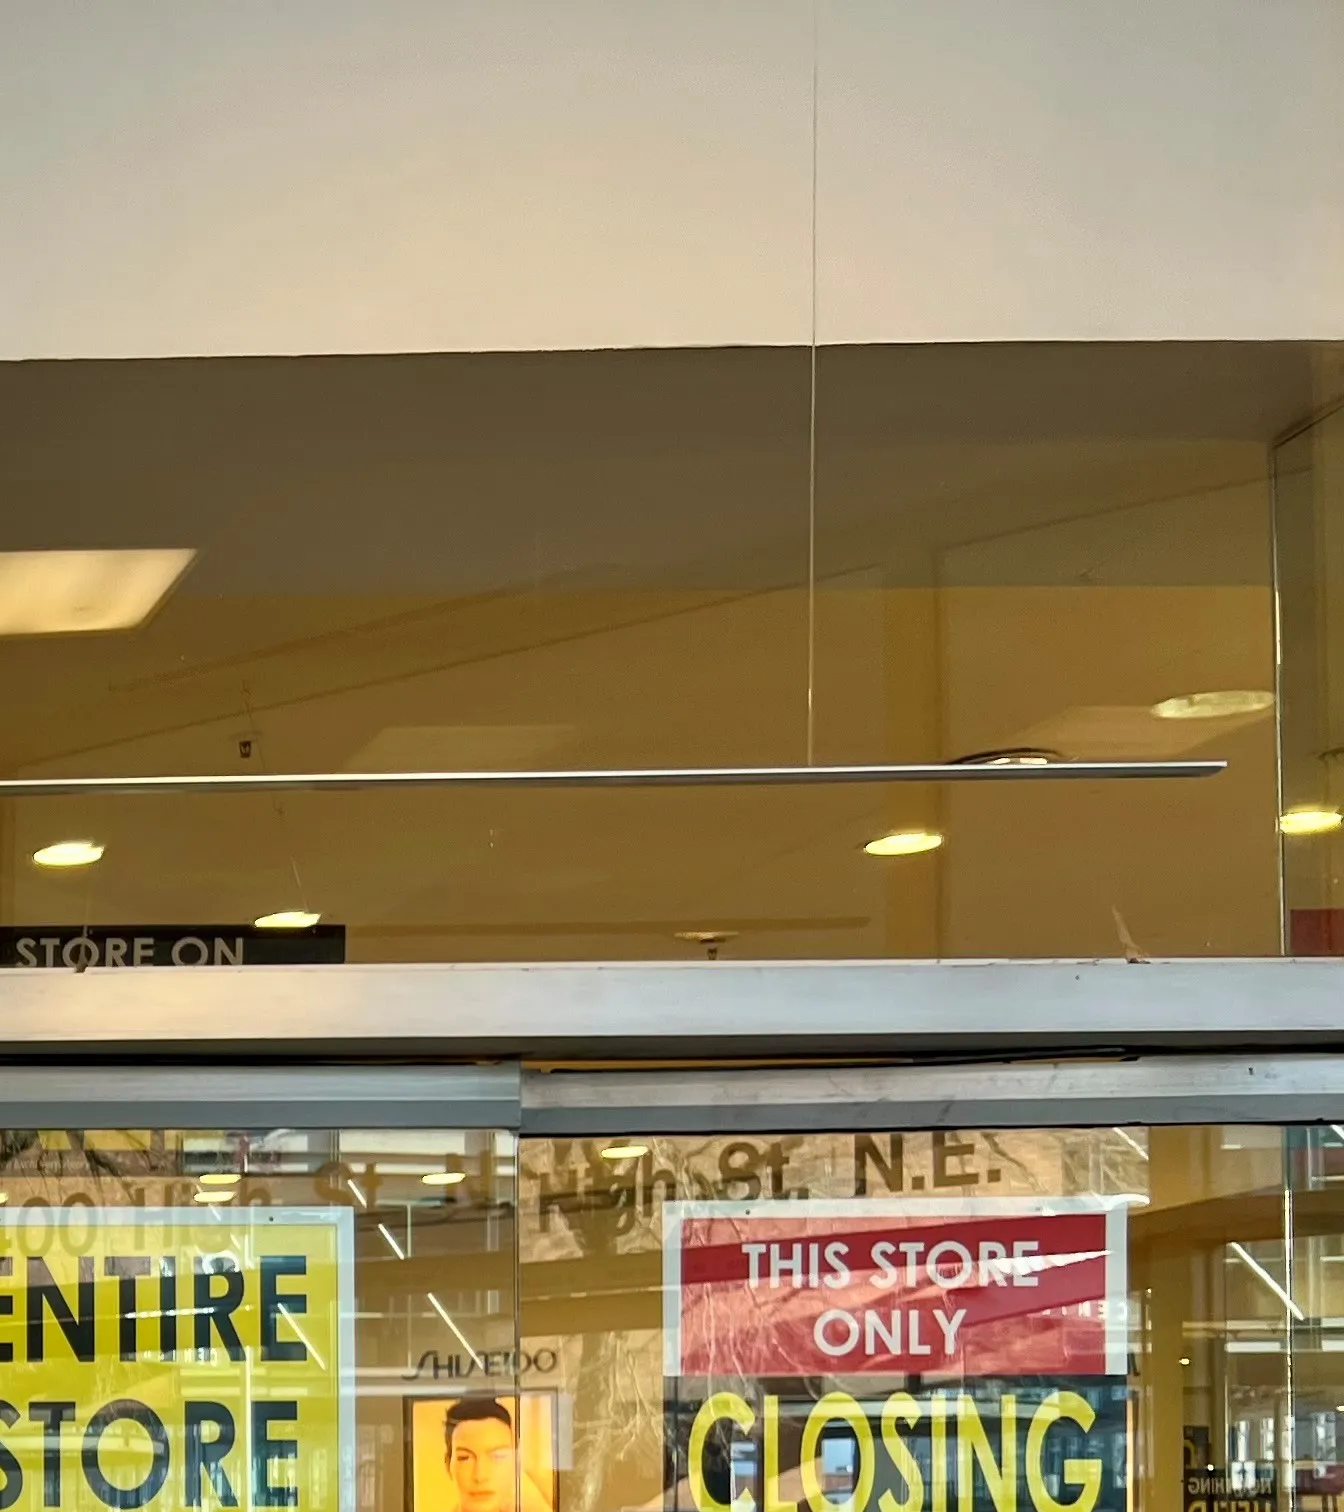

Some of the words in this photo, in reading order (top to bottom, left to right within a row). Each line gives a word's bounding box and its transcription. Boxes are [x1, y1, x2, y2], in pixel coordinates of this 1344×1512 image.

[16, 937, 153, 968] STORE
[172, 936, 244, 967] ON
[855, 1133, 1003, 1196] N.E.
[742, 1241, 850, 1289] THIS
[869, 1241, 1042, 1289] STORE
[814, 1308, 967, 1356] ONLY
